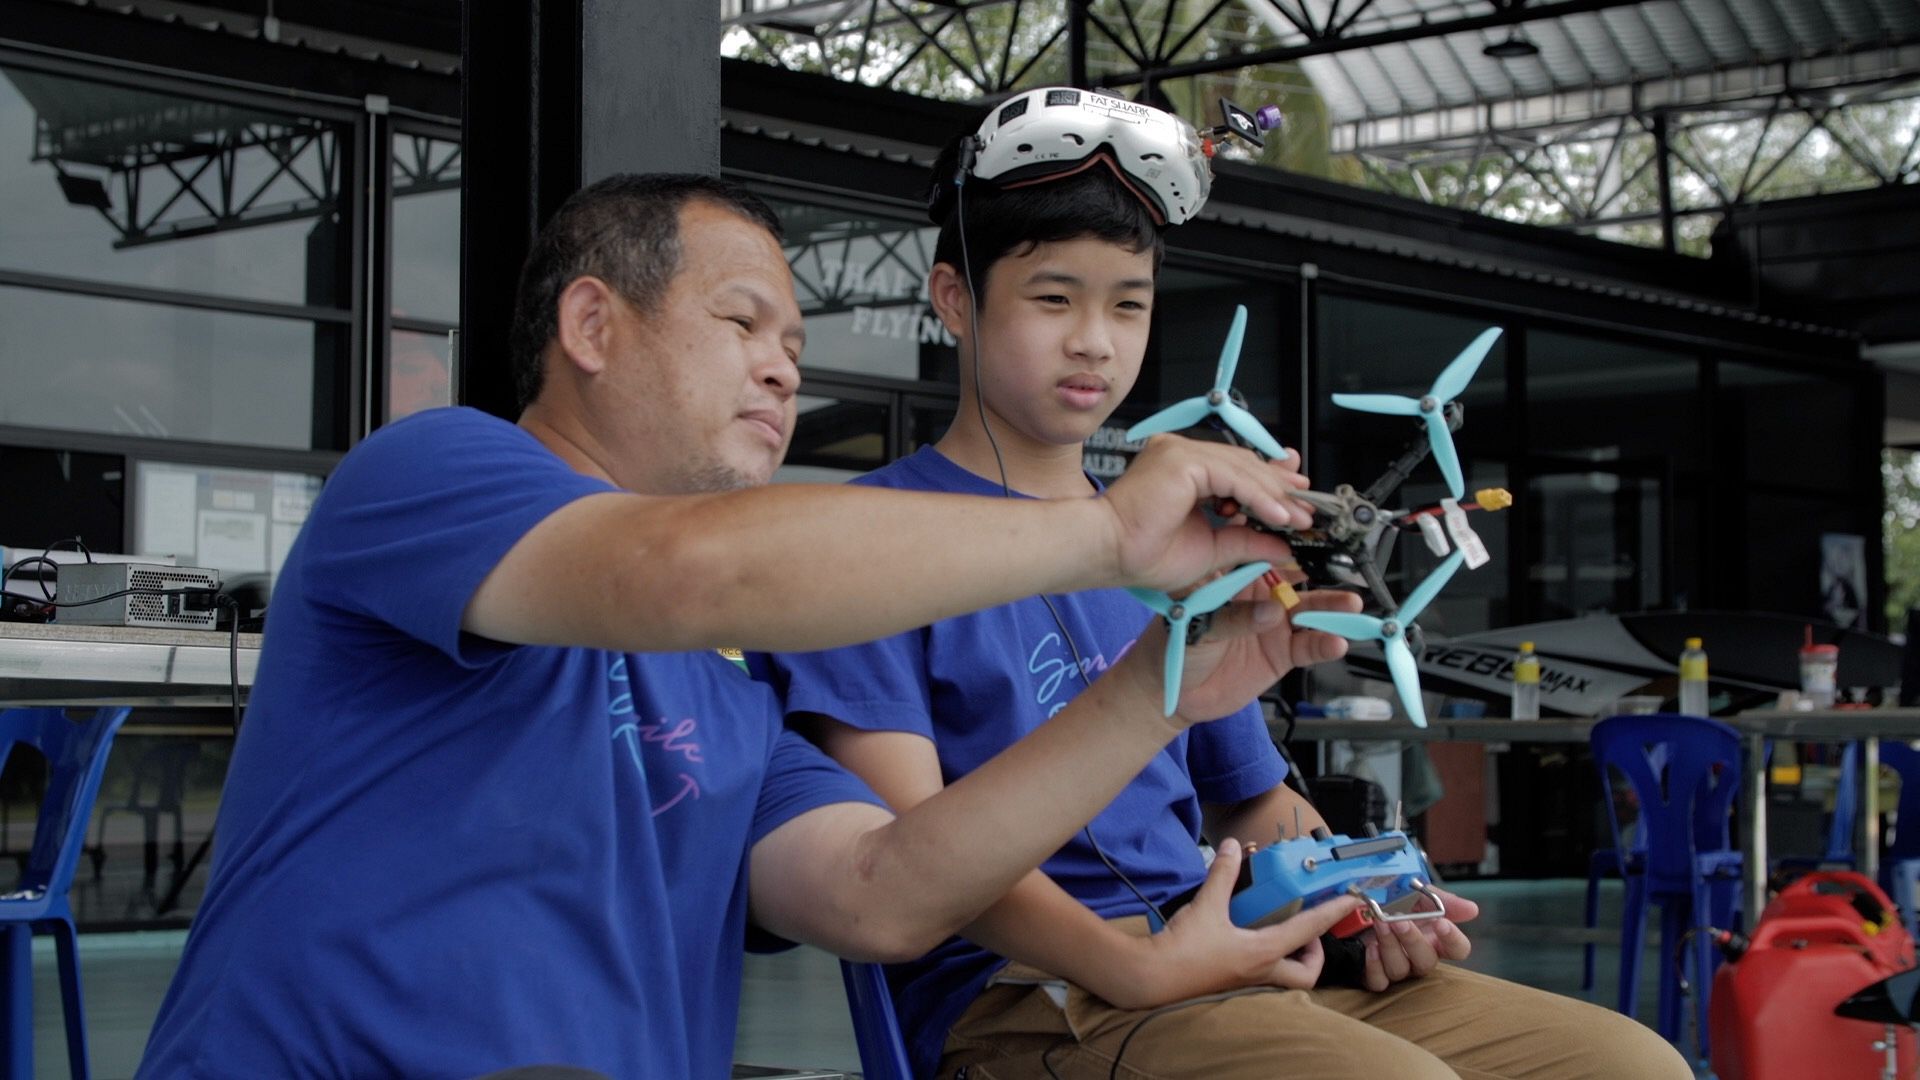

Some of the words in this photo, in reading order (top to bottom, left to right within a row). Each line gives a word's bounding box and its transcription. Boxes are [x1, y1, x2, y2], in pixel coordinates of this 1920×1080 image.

[1090, 95, 1107, 106] FAT
[1110, 100, 1150, 117] SHARK
[1543, 670, 1592, 693] MAX
